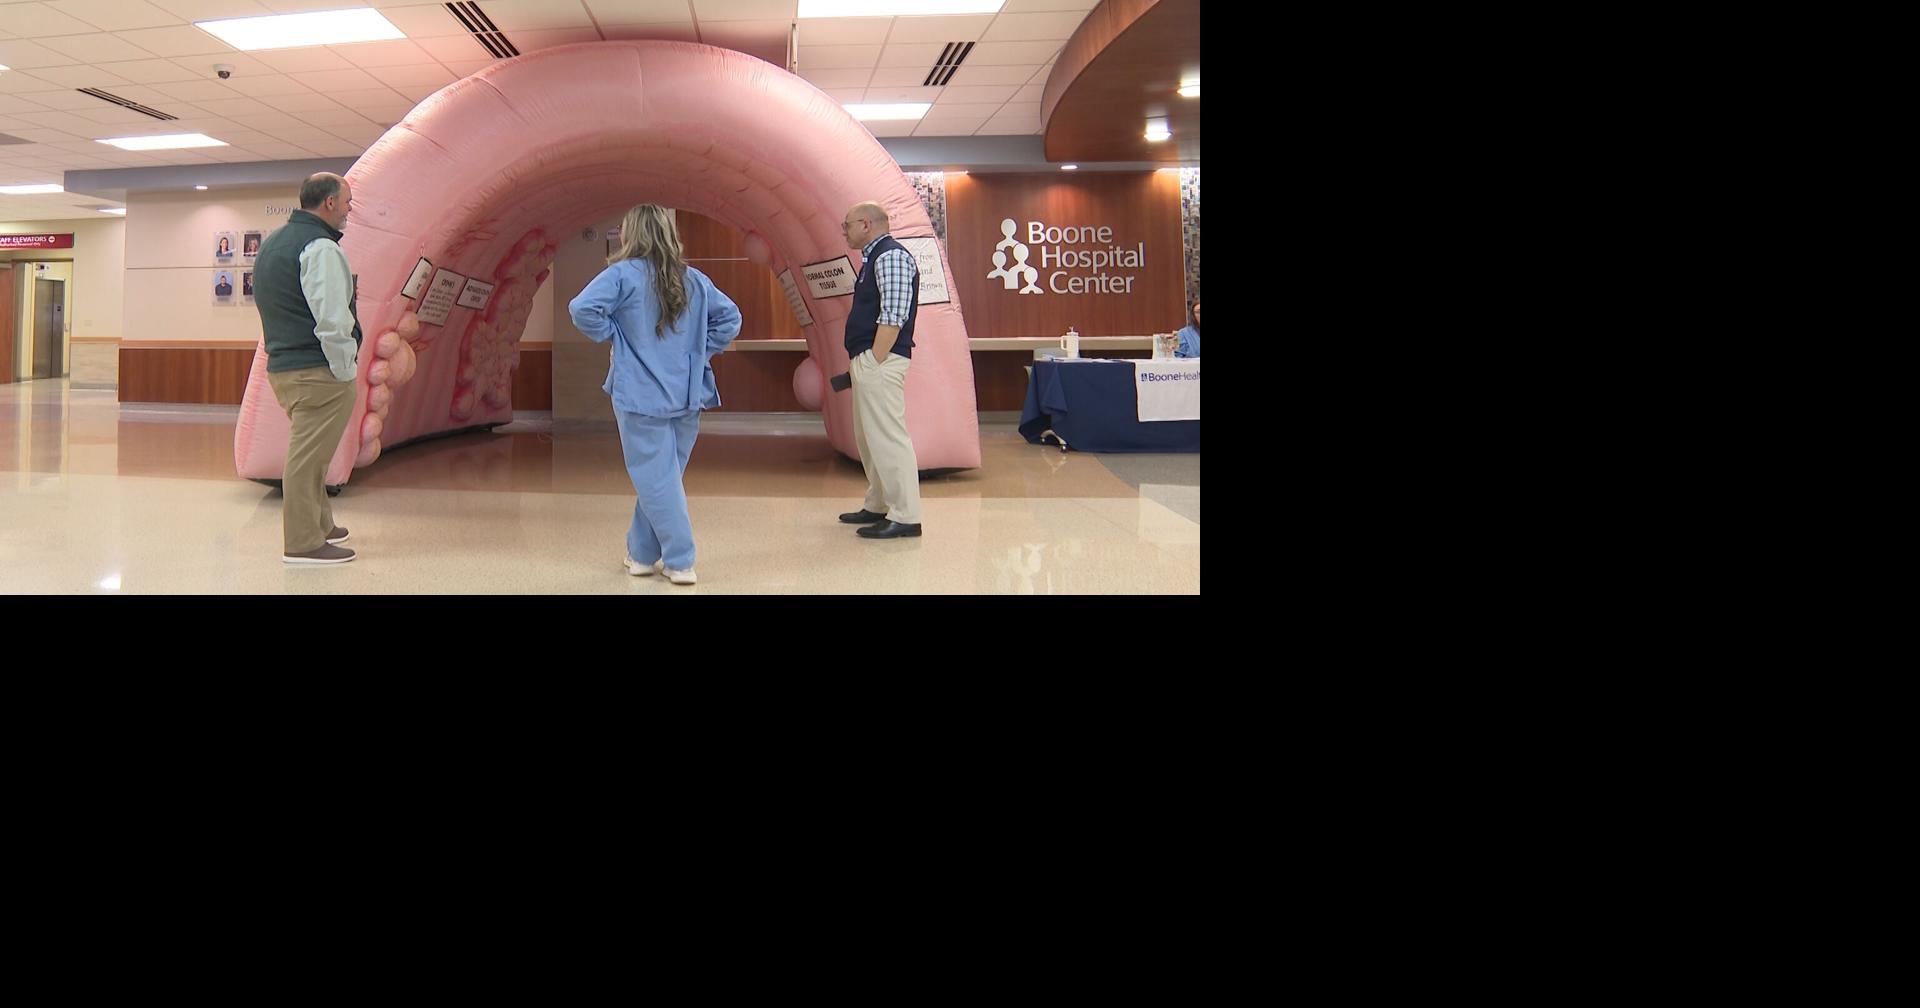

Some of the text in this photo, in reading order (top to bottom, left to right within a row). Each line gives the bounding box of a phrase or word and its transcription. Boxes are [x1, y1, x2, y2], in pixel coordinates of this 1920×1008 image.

[12, 235, 47, 243] ELEVATORS
[1027, 221, 1113, 244] Boone
[1041, 242, 1145, 275] Hospital
[825, 267, 845, 279] COLON
[1049, 271, 1134, 294] Center
